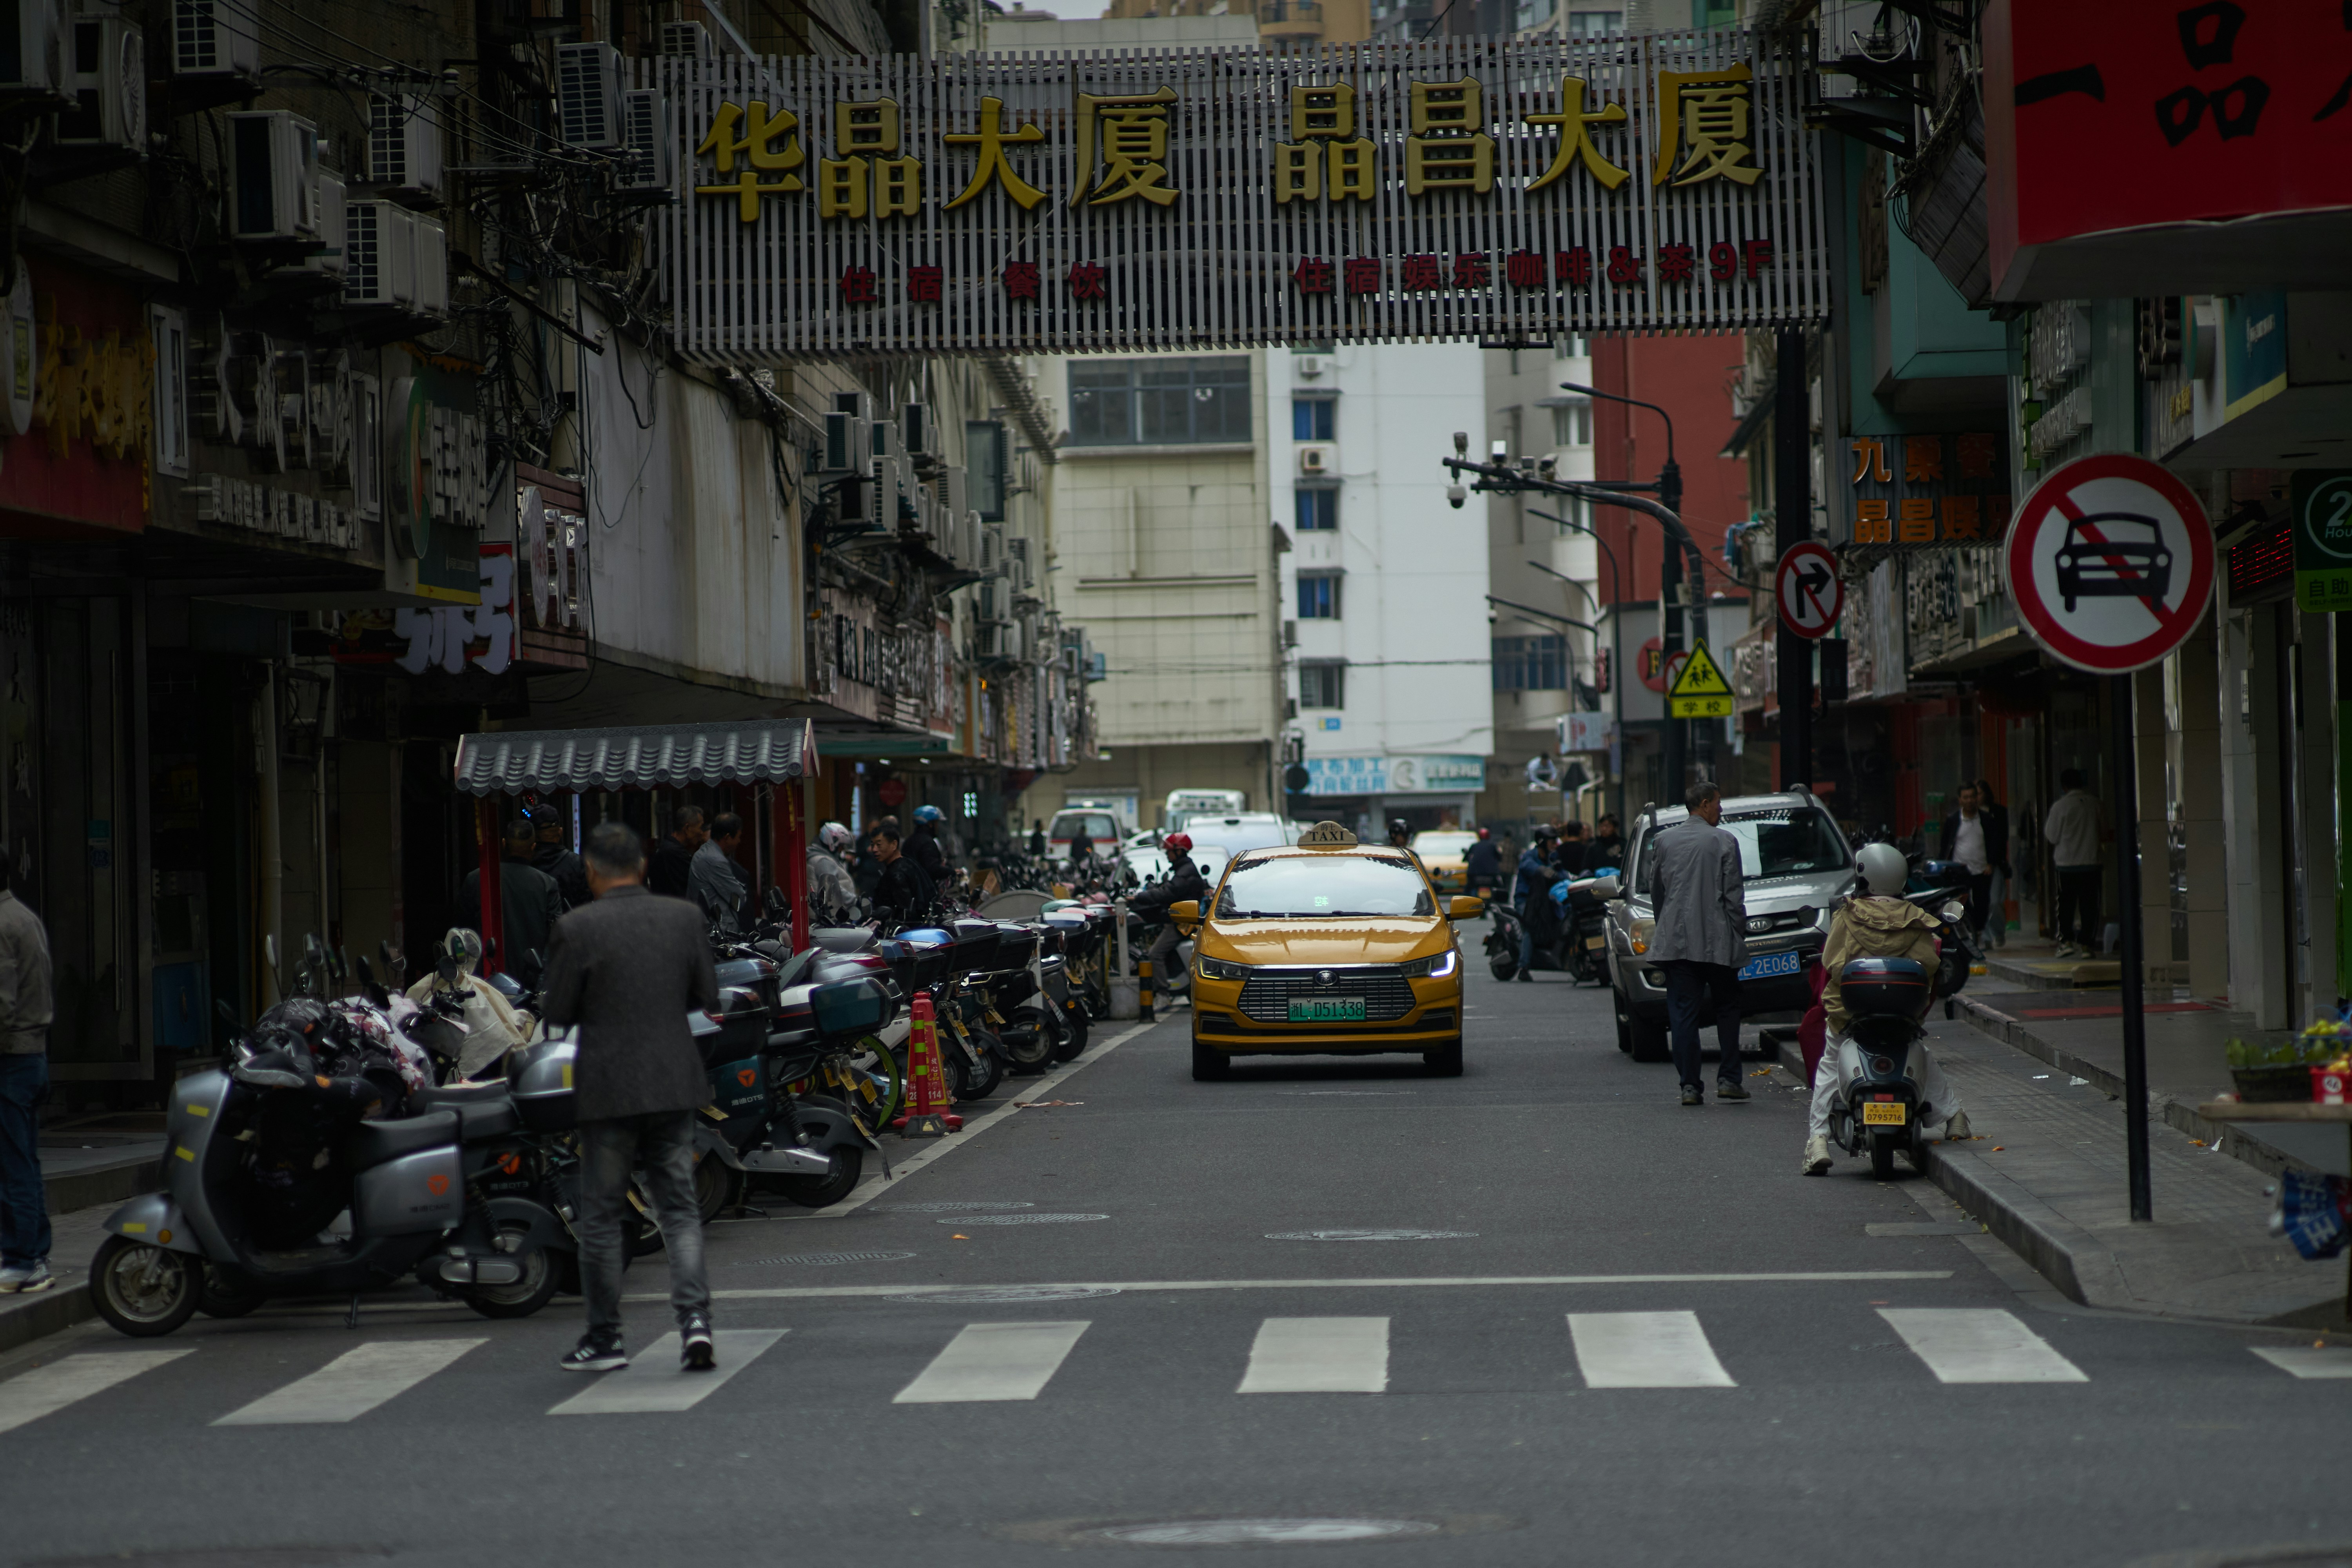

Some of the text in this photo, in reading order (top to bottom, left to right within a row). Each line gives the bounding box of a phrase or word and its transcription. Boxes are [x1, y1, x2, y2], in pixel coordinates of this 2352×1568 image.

[2015, 0, 2352, 147] 一品
[1274, 62, 1765, 205] 晶昌大厦
[694, 85, 1181, 223] 华晶大厦
[840, 260, 1106, 303] 住宿 餐饮
[2327, 490, 2352, 527] 2
[2309, 577, 2349, 598] 自助
[1683, 701, 1721, 714] 学校
[1310, 831, 1344, 841] TAXI
[1314, 895, 1329, 907] 空车
[1750, 920, 1768, 930] KIA
[1745, 939, 1782, 947] PORTAGE
